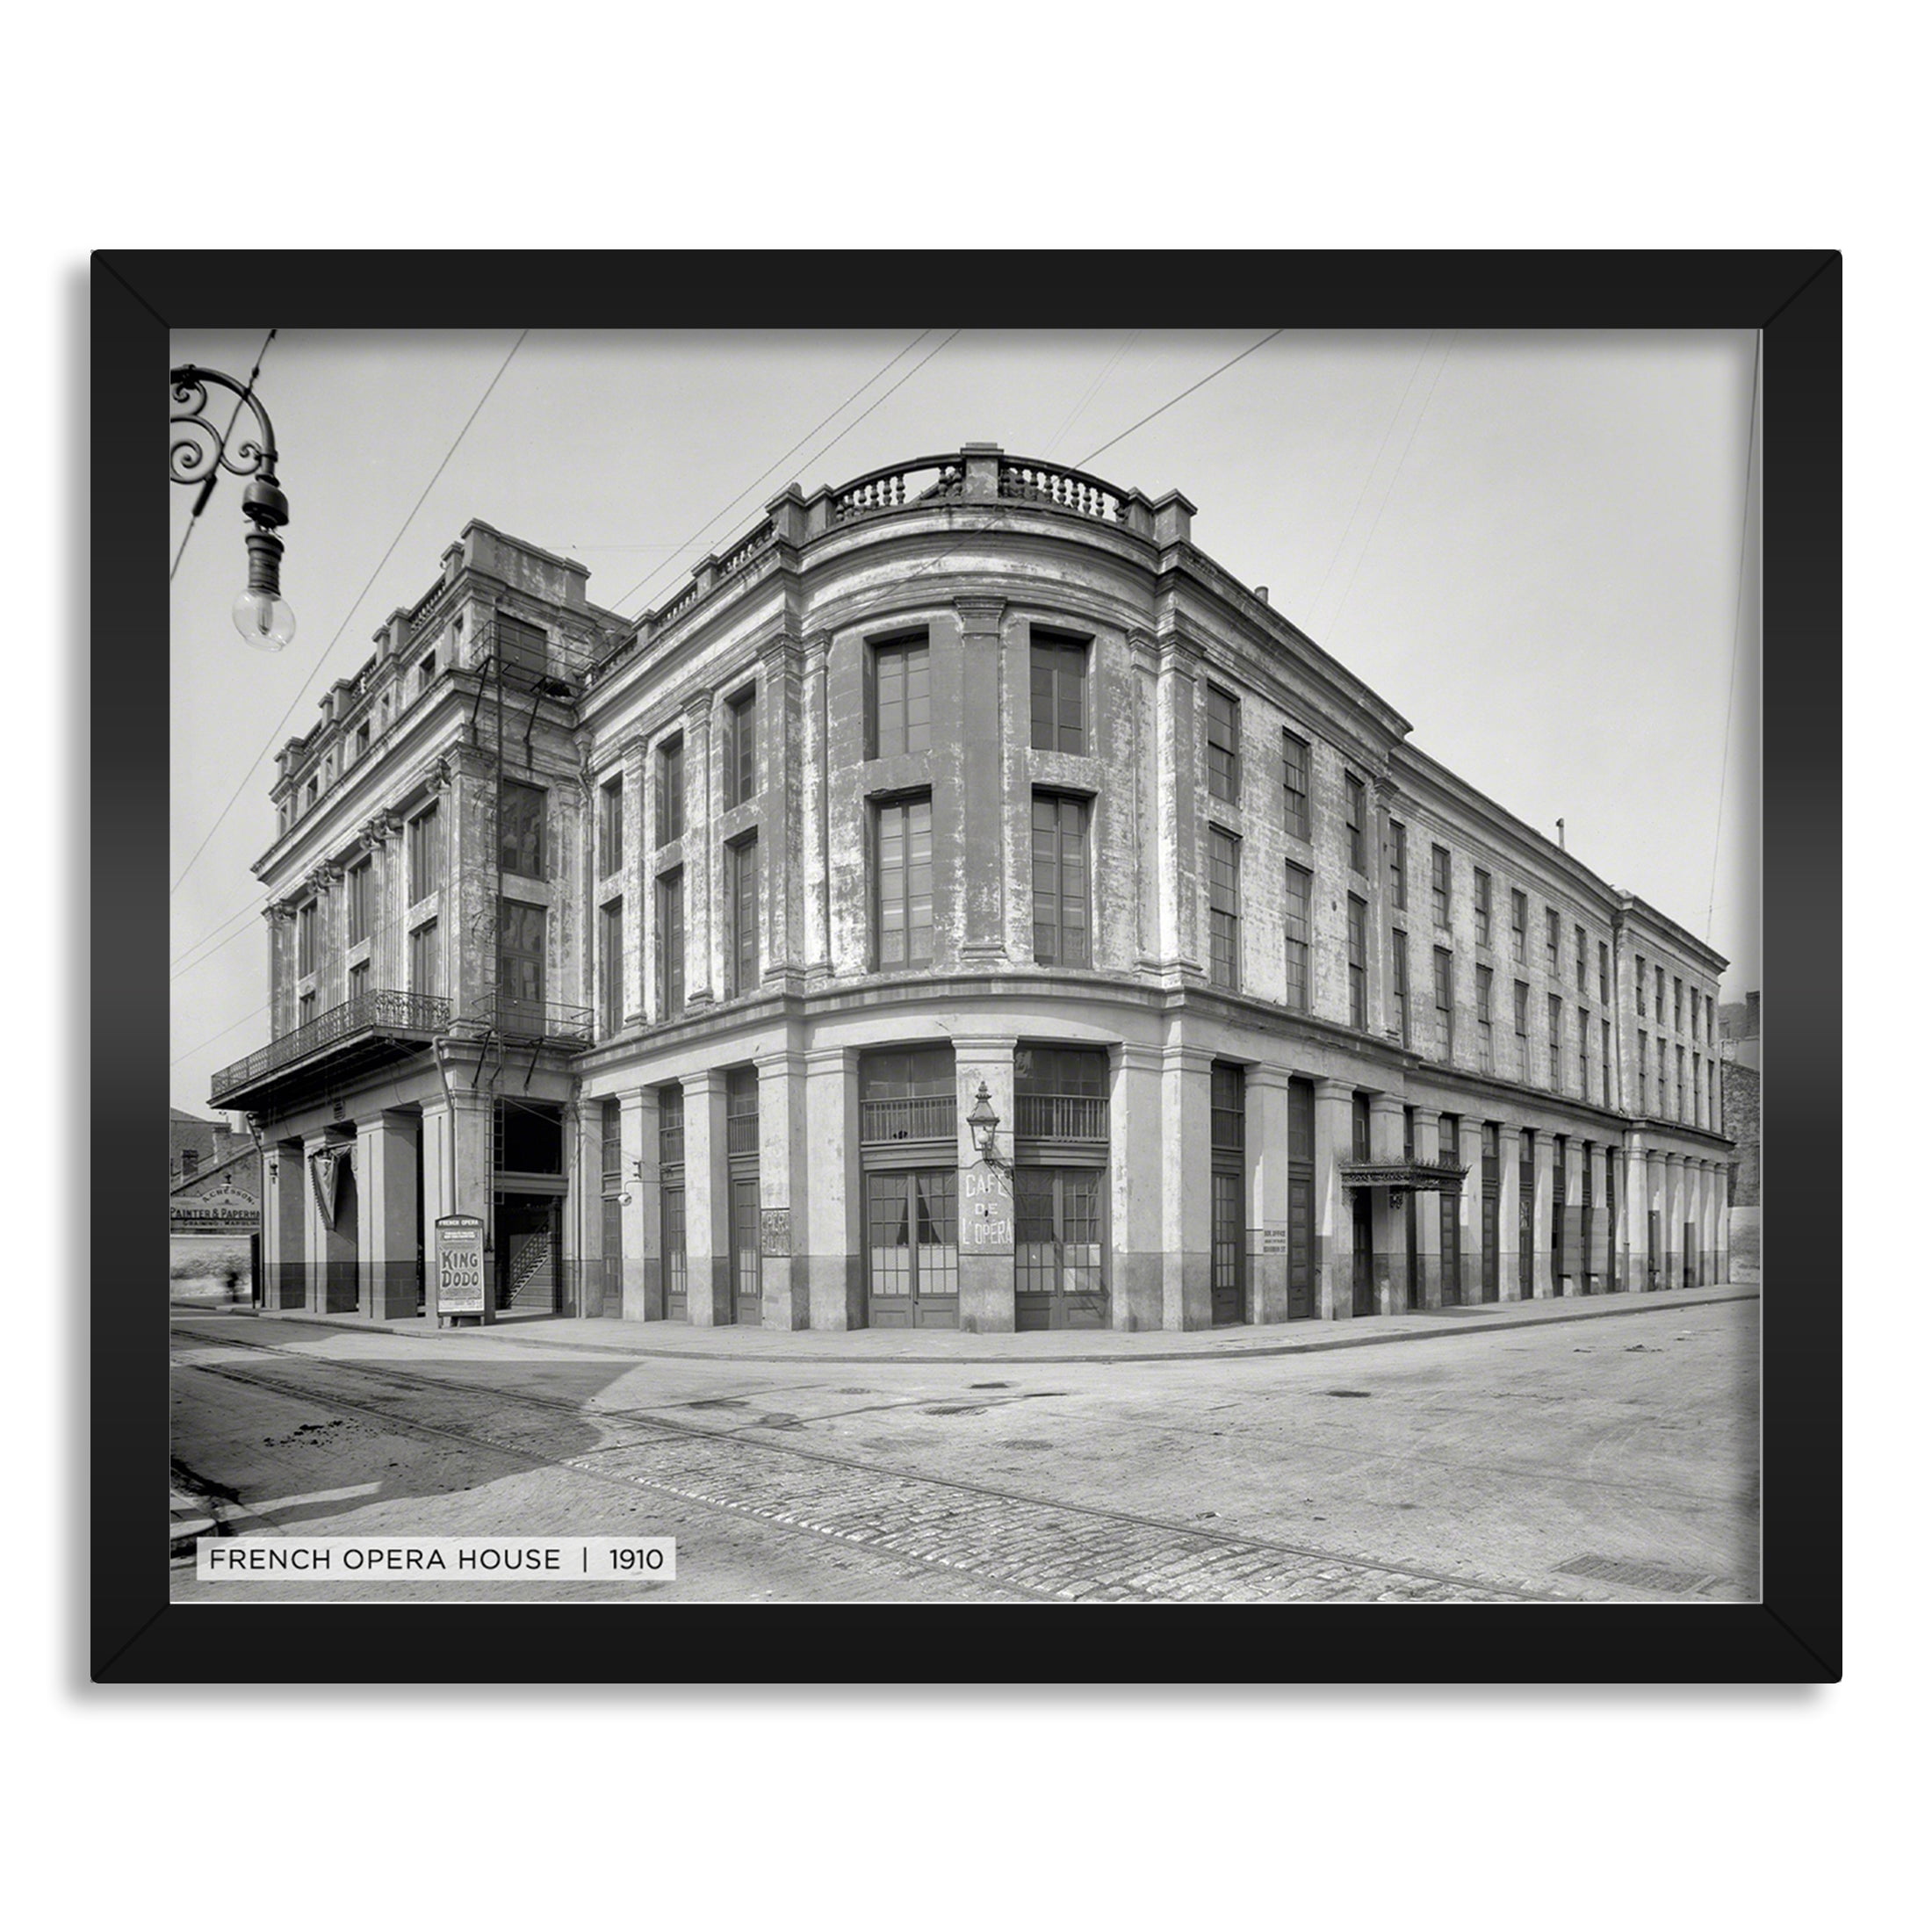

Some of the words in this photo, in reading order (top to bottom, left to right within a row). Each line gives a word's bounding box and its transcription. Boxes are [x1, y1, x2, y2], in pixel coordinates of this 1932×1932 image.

[170, 1207, 211, 1219] PAINTER
[975, 1202, 998, 1215] DE
[442, 1250, 479, 1271] KING
[441, 1270, 479, 1288] DODO
